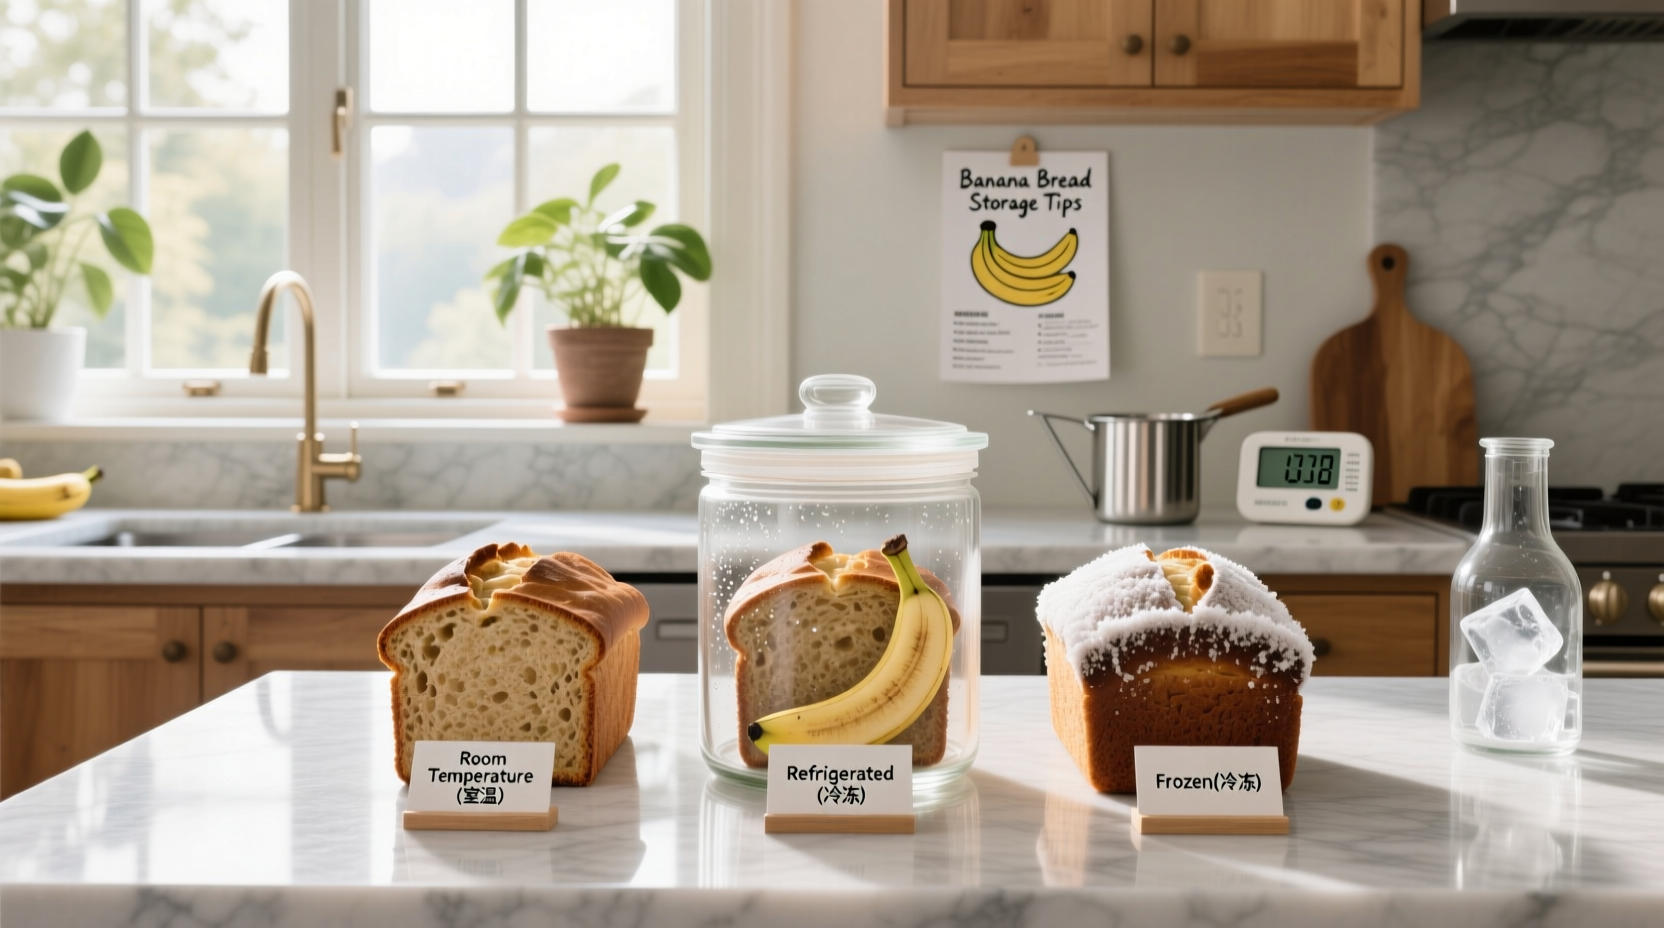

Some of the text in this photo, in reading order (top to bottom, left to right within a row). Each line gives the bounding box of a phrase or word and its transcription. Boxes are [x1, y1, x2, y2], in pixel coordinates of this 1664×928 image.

[959, 167, 1092, 190] Banana Bread
[969, 192, 1083, 219] Storage Tips
[459, 750, 507, 766] Room
[427, 767, 534, 784] Temperature
[787, 764, 894, 785] Refrigerated
[1156, 771, 1262, 793] Frozen(冷冻)
[456, 785, 504, 806] (室温)
[817, 785, 866, 806] (冷冻)
